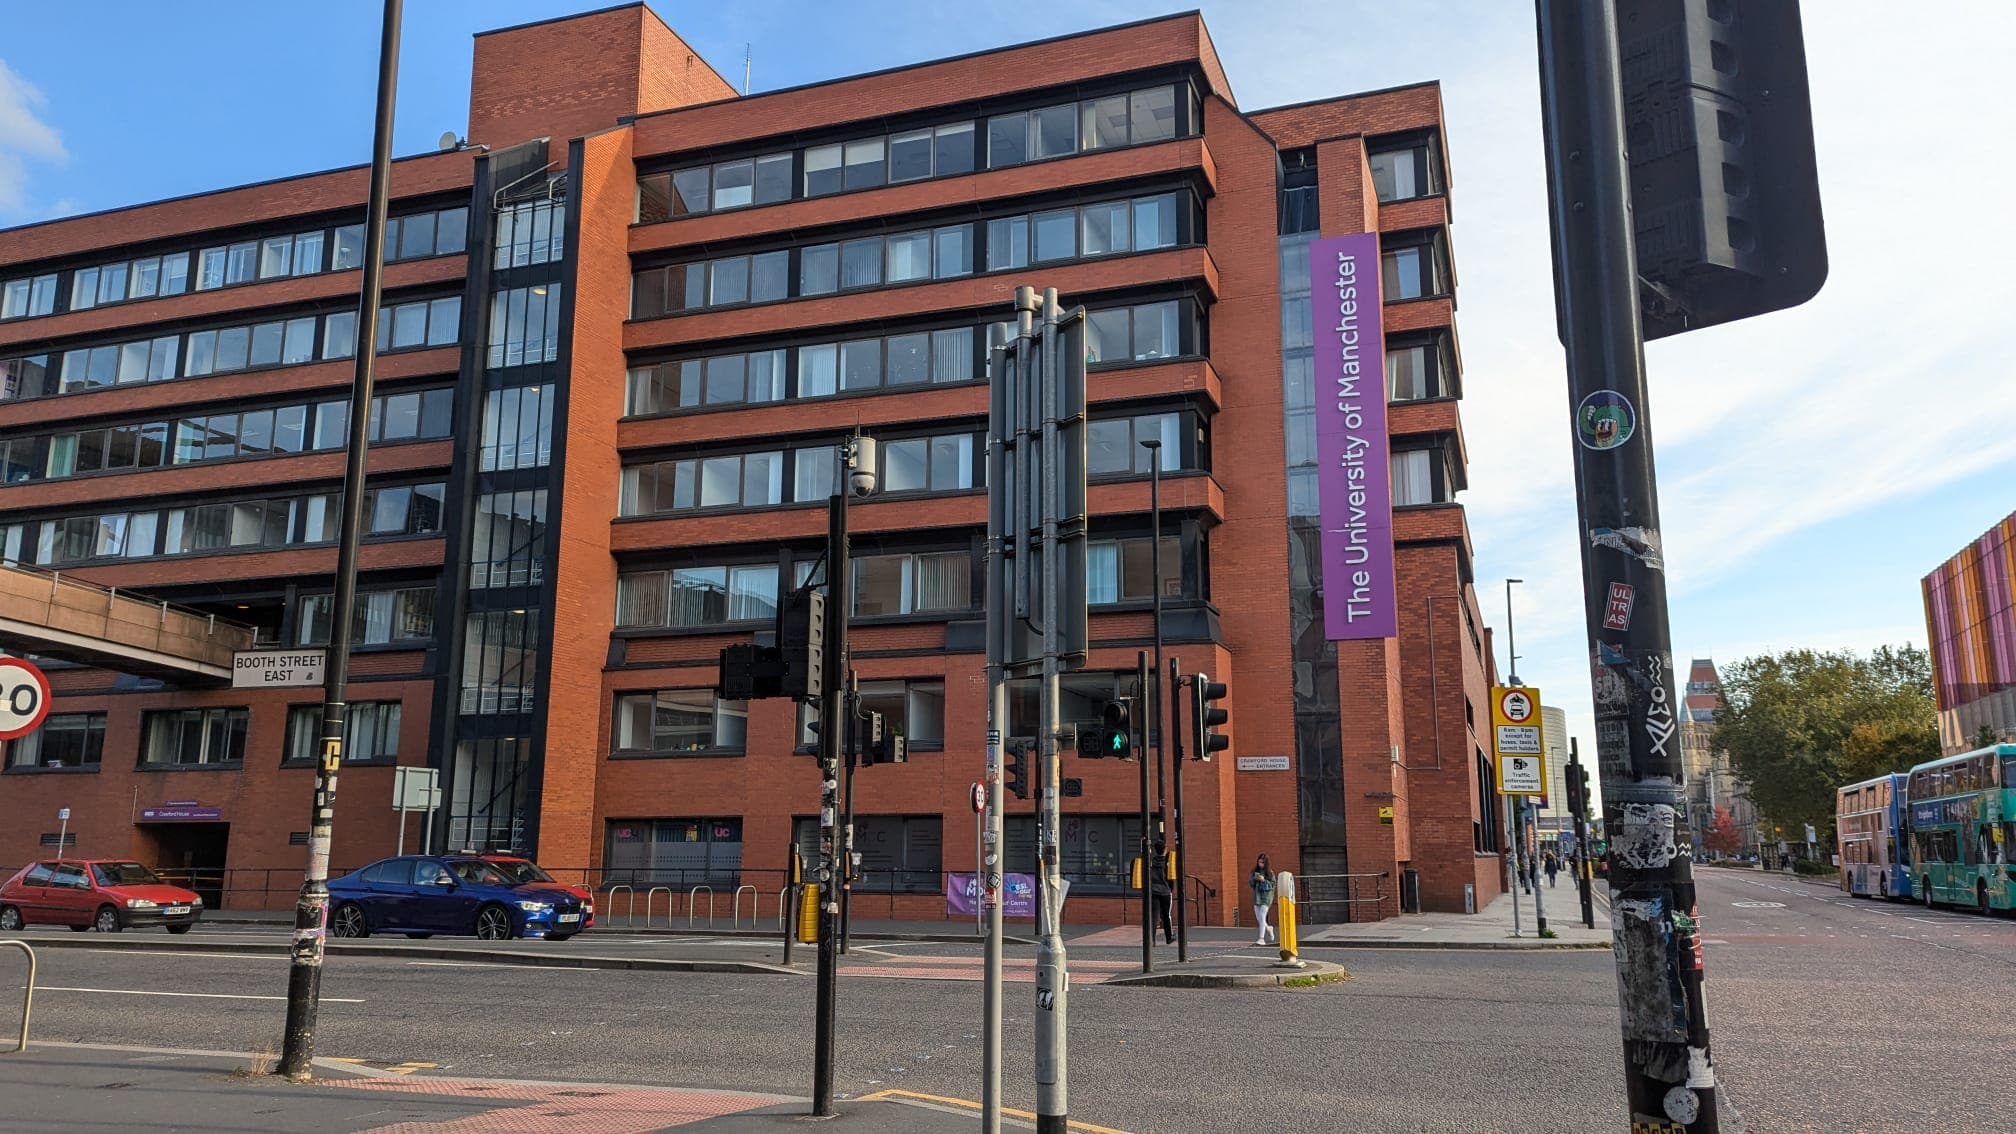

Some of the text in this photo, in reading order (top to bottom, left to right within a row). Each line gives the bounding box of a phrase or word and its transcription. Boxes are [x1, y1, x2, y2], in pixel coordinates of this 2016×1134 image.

[1336, 252, 1371, 623] The University of Manchester
[1613, 588, 1630, 600] UL
[1610, 600, 1628, 613] TR
[1608, 613, 1625, 625] AS
[236, 655, 324, 669] BOOTH STREET
[264, 669, 294, 682] EAST
